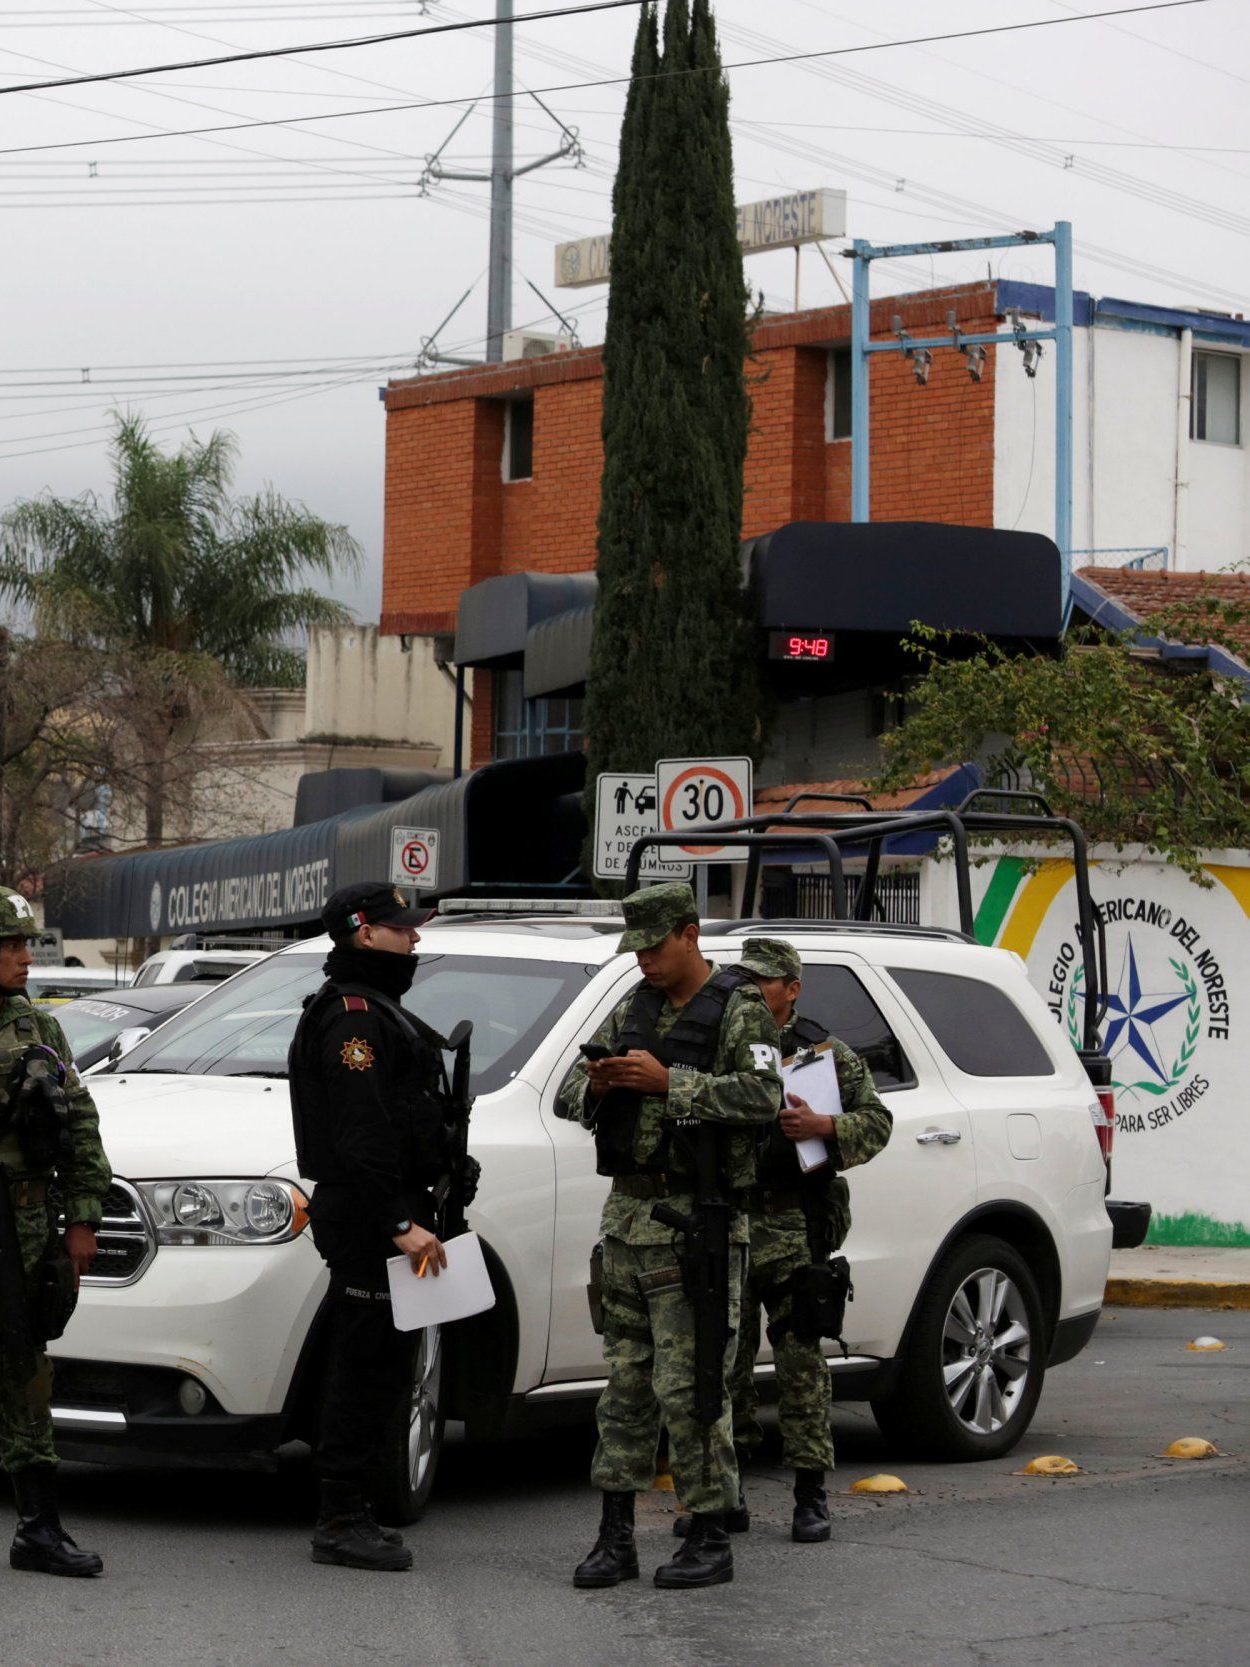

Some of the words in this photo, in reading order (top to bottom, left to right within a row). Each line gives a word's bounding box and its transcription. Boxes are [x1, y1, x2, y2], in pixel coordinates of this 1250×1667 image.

[789, 637, 828, 657] 9:48
[682, 784, 724, 821] 30
[615, 825, 657, 836] ASCEN
[605, 841, 613, 852] Y
[605, 857, 620, 869] DE
[624, 859, 683, 872] AUMNOS
[168, 880, 217, 928] COLEGIO
[218, 874, 264, 921] AMERICANO
[265, 871, 283, 917] DEL
[284, 858, 329, 914] NORESTE
[1048, 942, 1075, 1024] LEGIO
[1074, 897, 1172, 946] ERICANO
[1169, 917, 1201, 955] DEL
[1194, 948, 1230, 1040] NORESTE
[1147, 1105, 1173, 1130] SER
[1170, 1073, 1210, 1117] LIBRES
